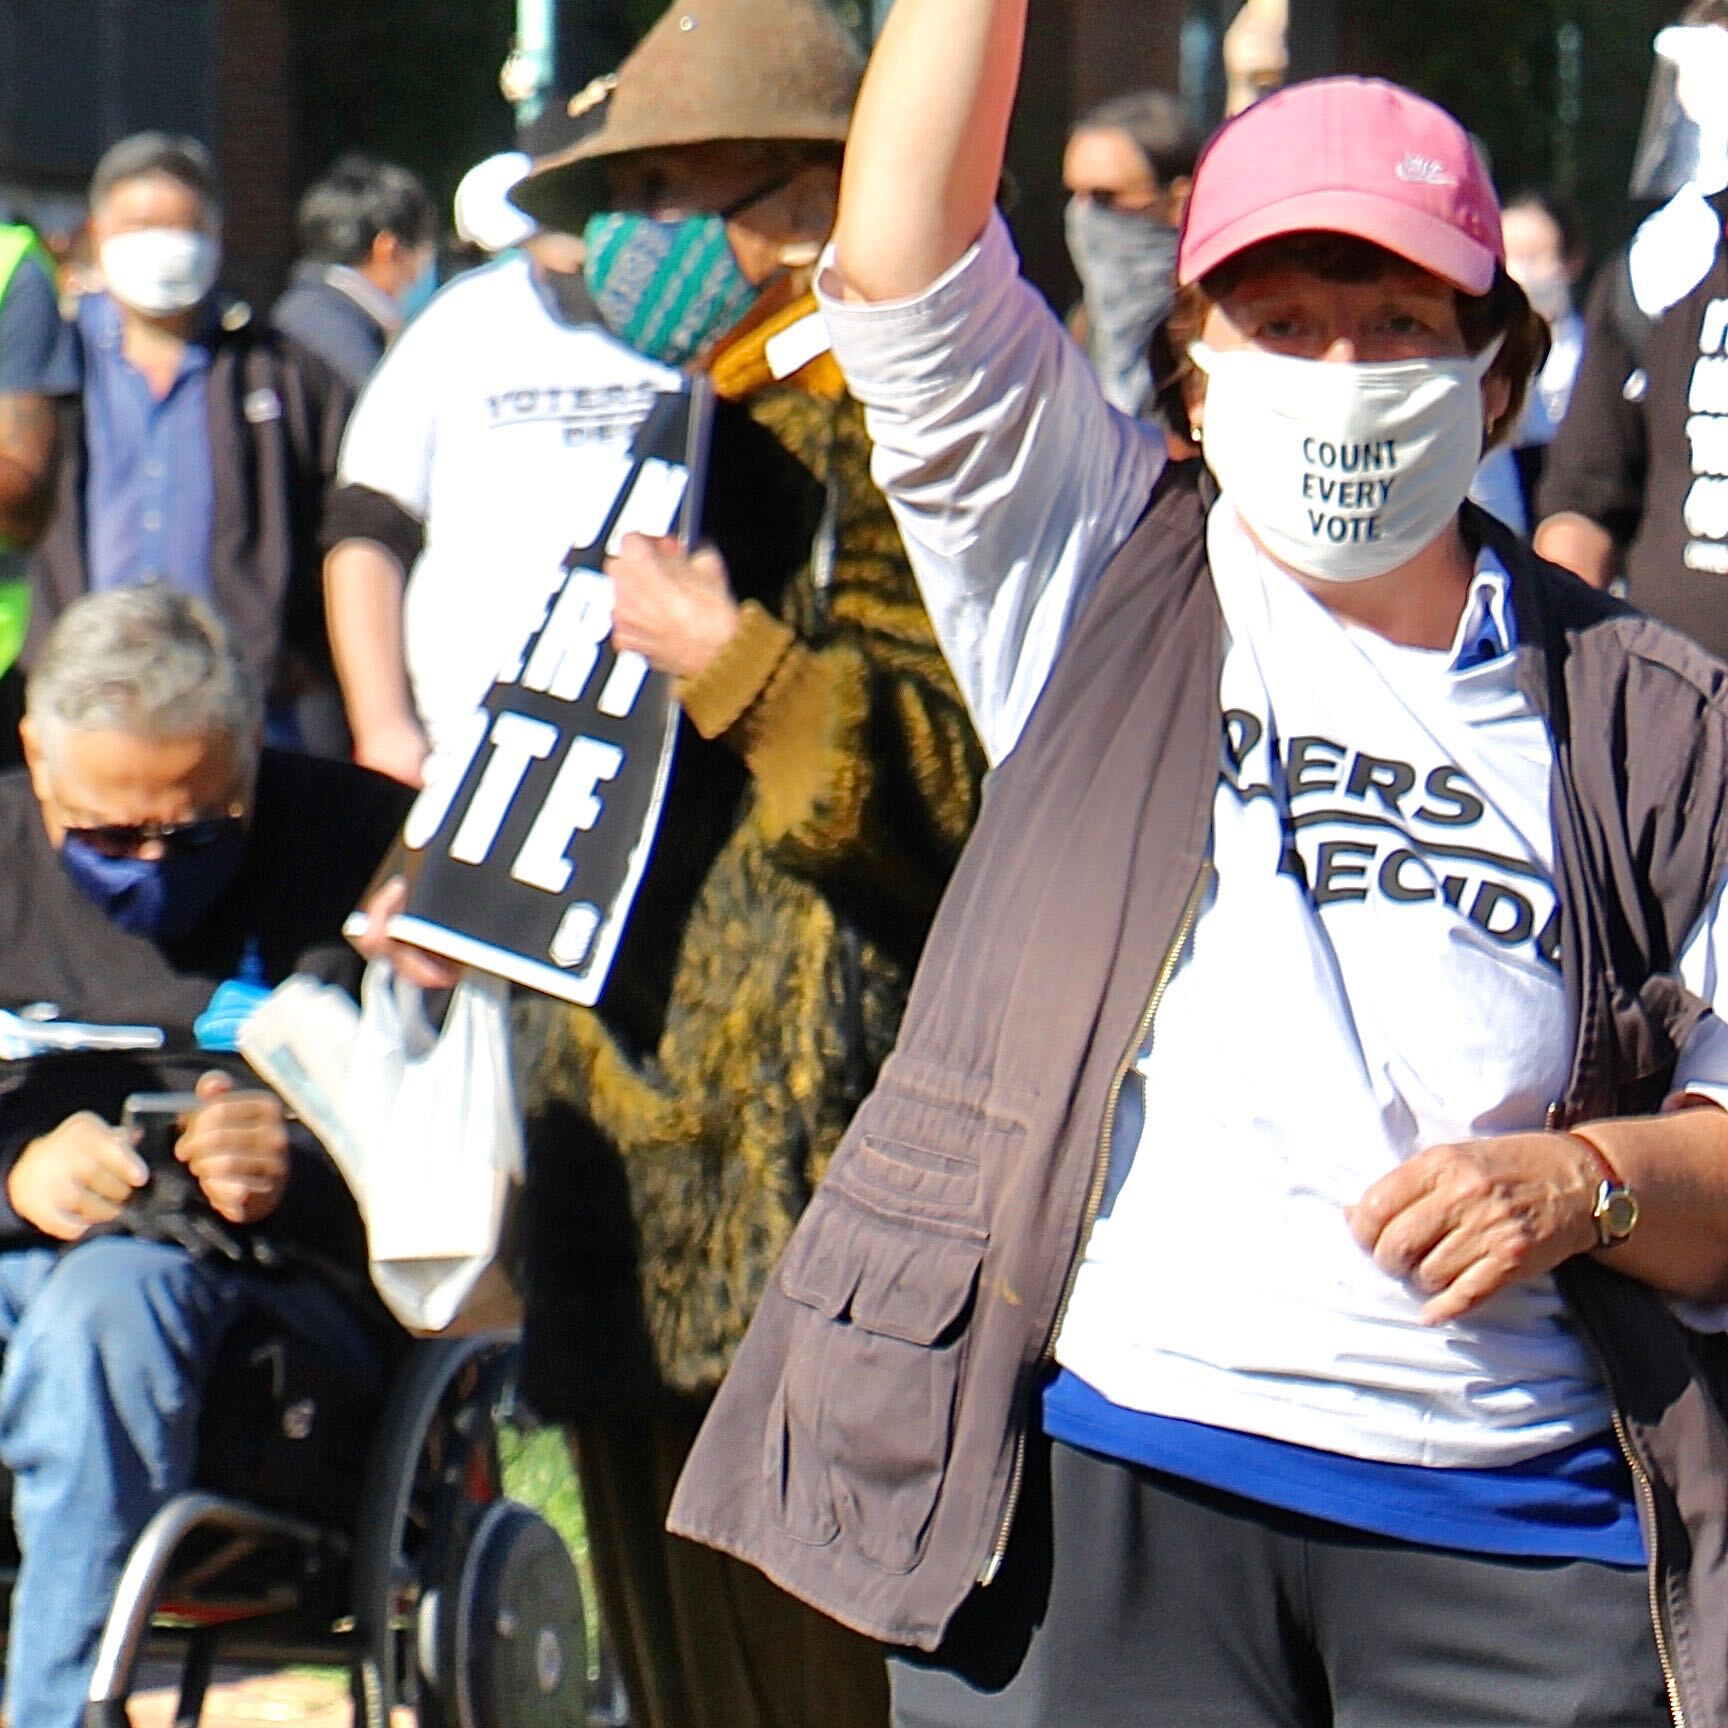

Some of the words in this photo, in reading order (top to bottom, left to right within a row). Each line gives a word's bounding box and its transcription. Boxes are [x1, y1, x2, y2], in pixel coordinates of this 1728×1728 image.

[1303, 436, 1396, 472] COUNT
[1303, 472, 1397, 508] EVERY
[1307, 508, 1381, 543] VOTE
